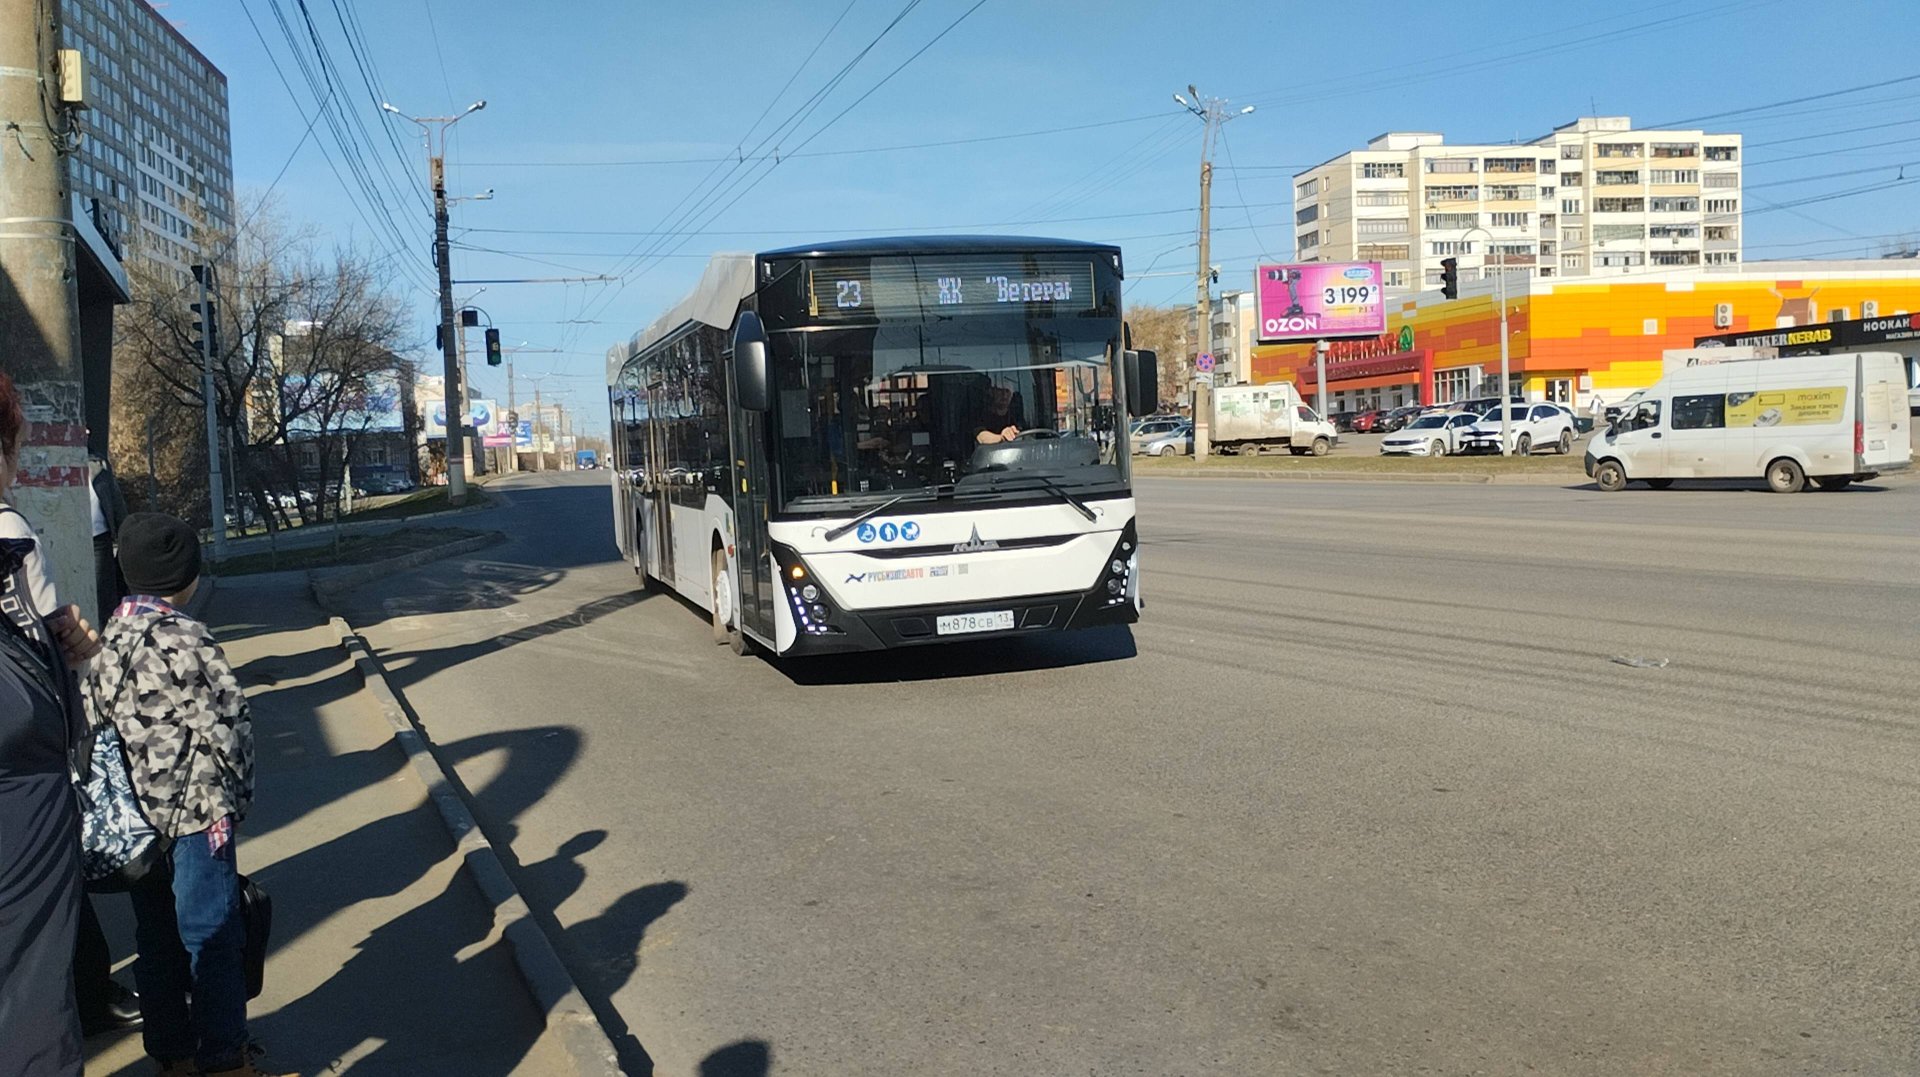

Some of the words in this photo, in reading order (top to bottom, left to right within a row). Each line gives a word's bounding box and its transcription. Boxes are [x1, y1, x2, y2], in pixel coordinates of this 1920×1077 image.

[836, 280, 862, 307] 23
[937, 277, 963, 304] ЖК
[1265, 317, 1317, 333] OZON
[1863, 318, 1910, 332] HOOKAH
[1787, 329, 1832, 345] KEBAB
[1797, 391, 1831, 401] maxim
[998, 613, 1009, 622] 13
